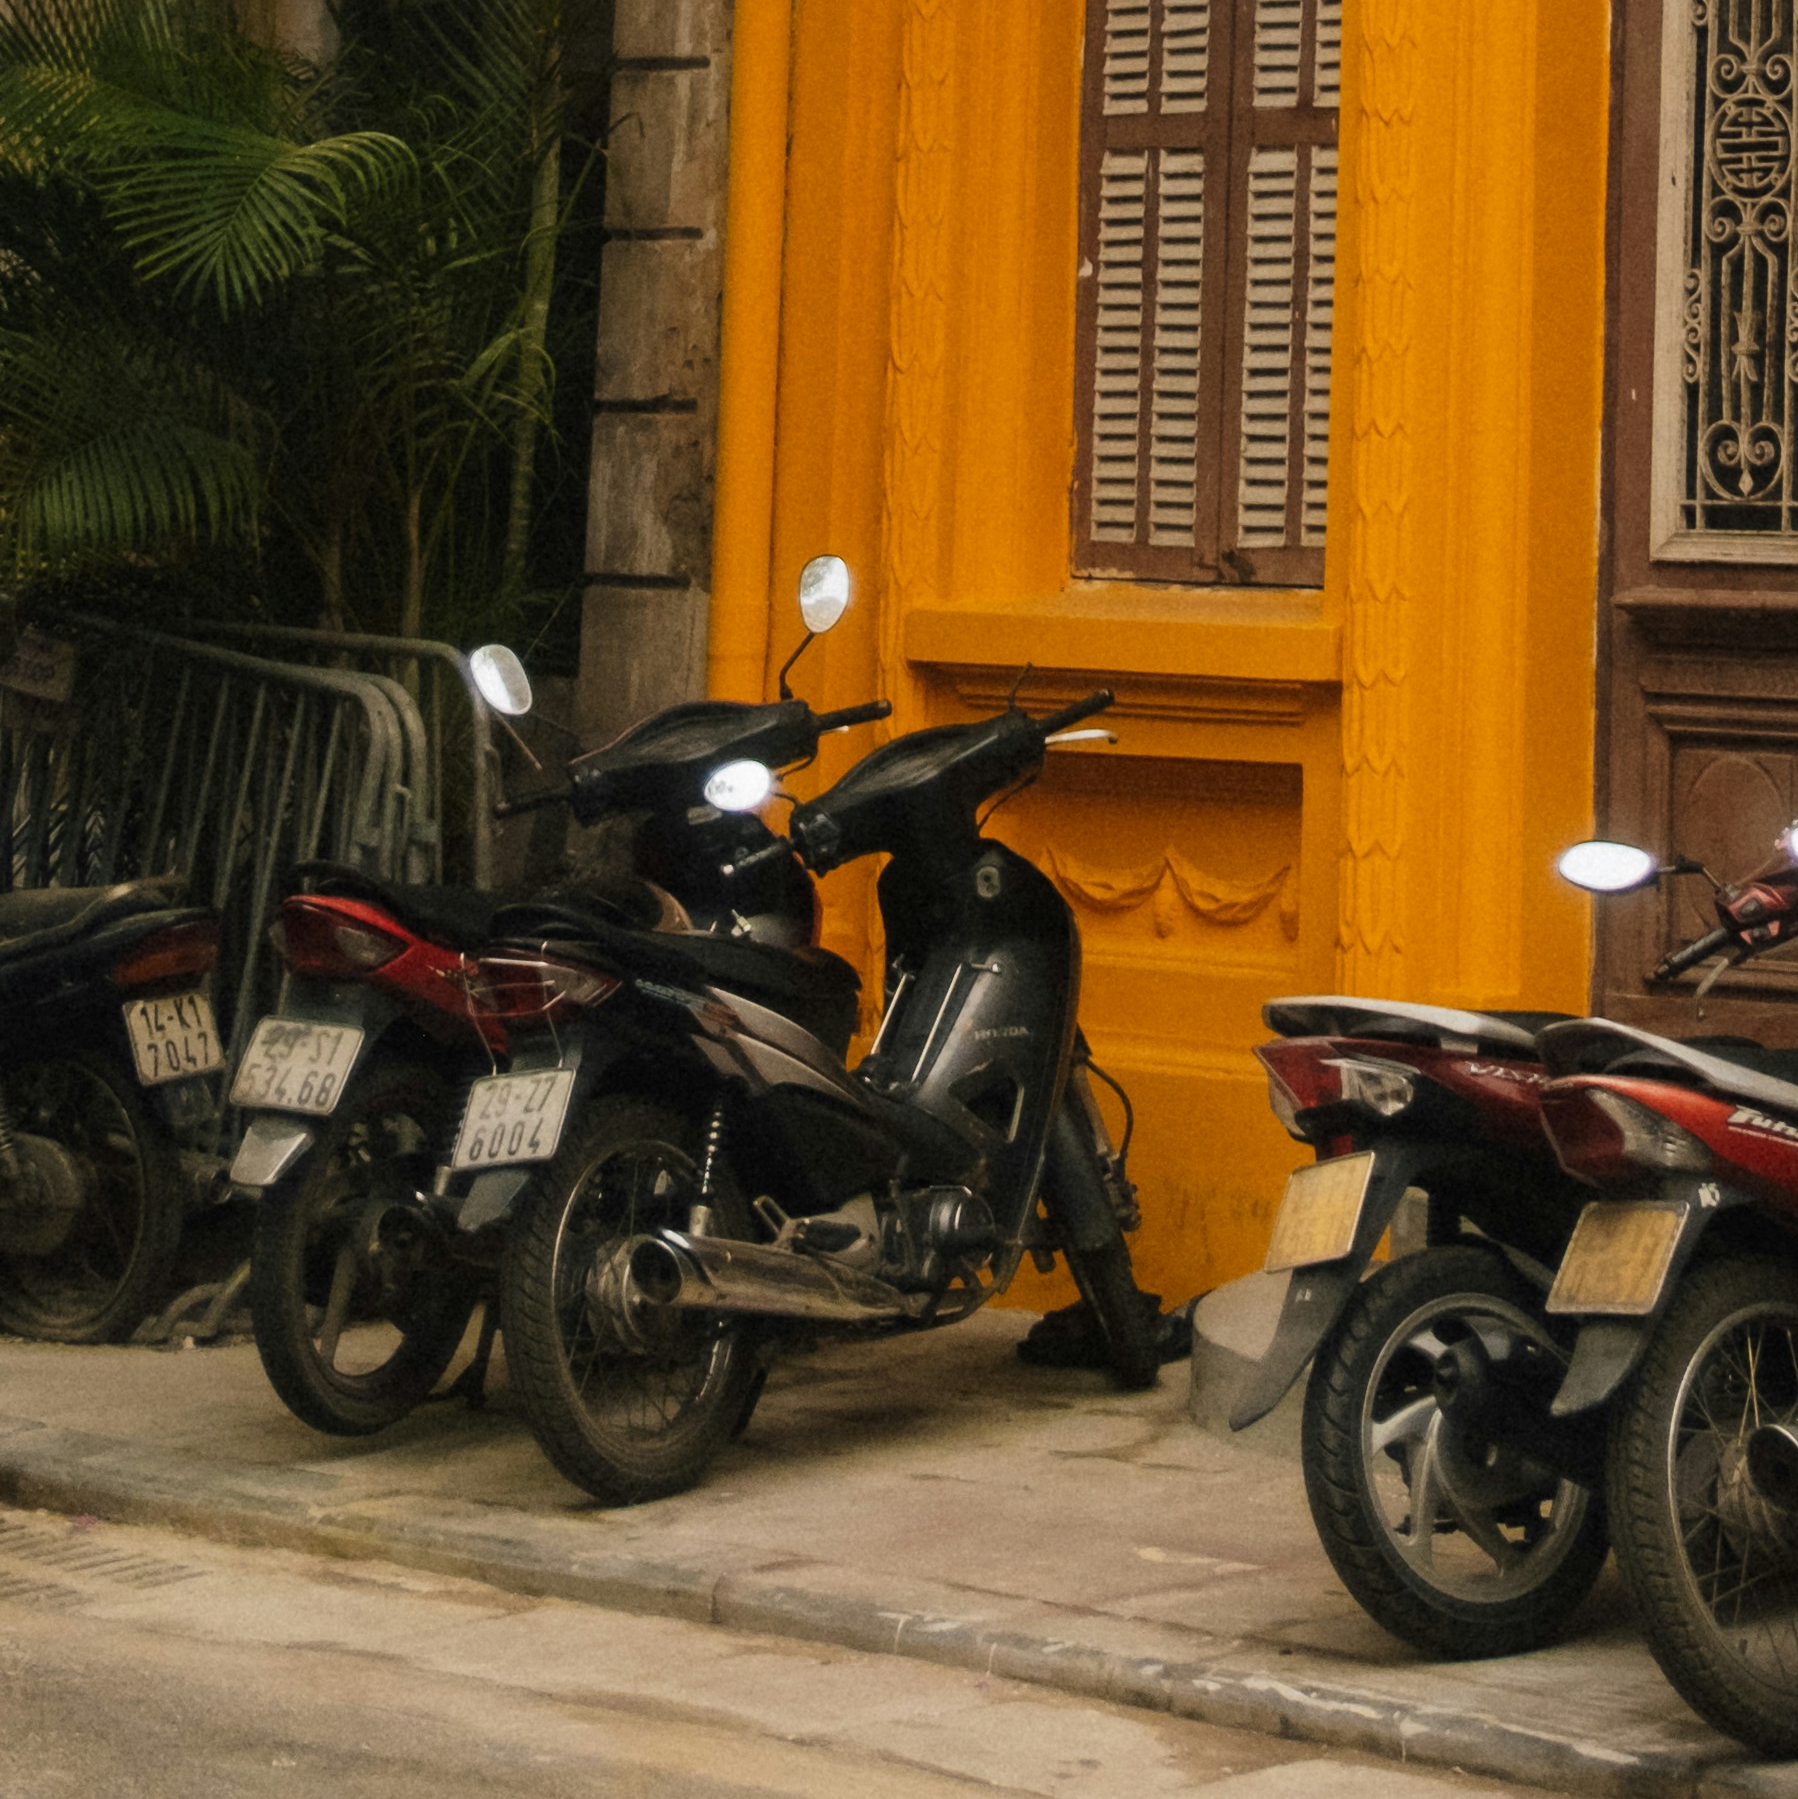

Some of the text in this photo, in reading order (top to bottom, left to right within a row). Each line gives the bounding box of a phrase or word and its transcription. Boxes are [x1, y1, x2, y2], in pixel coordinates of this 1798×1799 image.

[140, 995, 203, 1038] 14-K1
[147, 1031, 209, 1077] 7047
[469, 1116, 544, 1161] 6004
